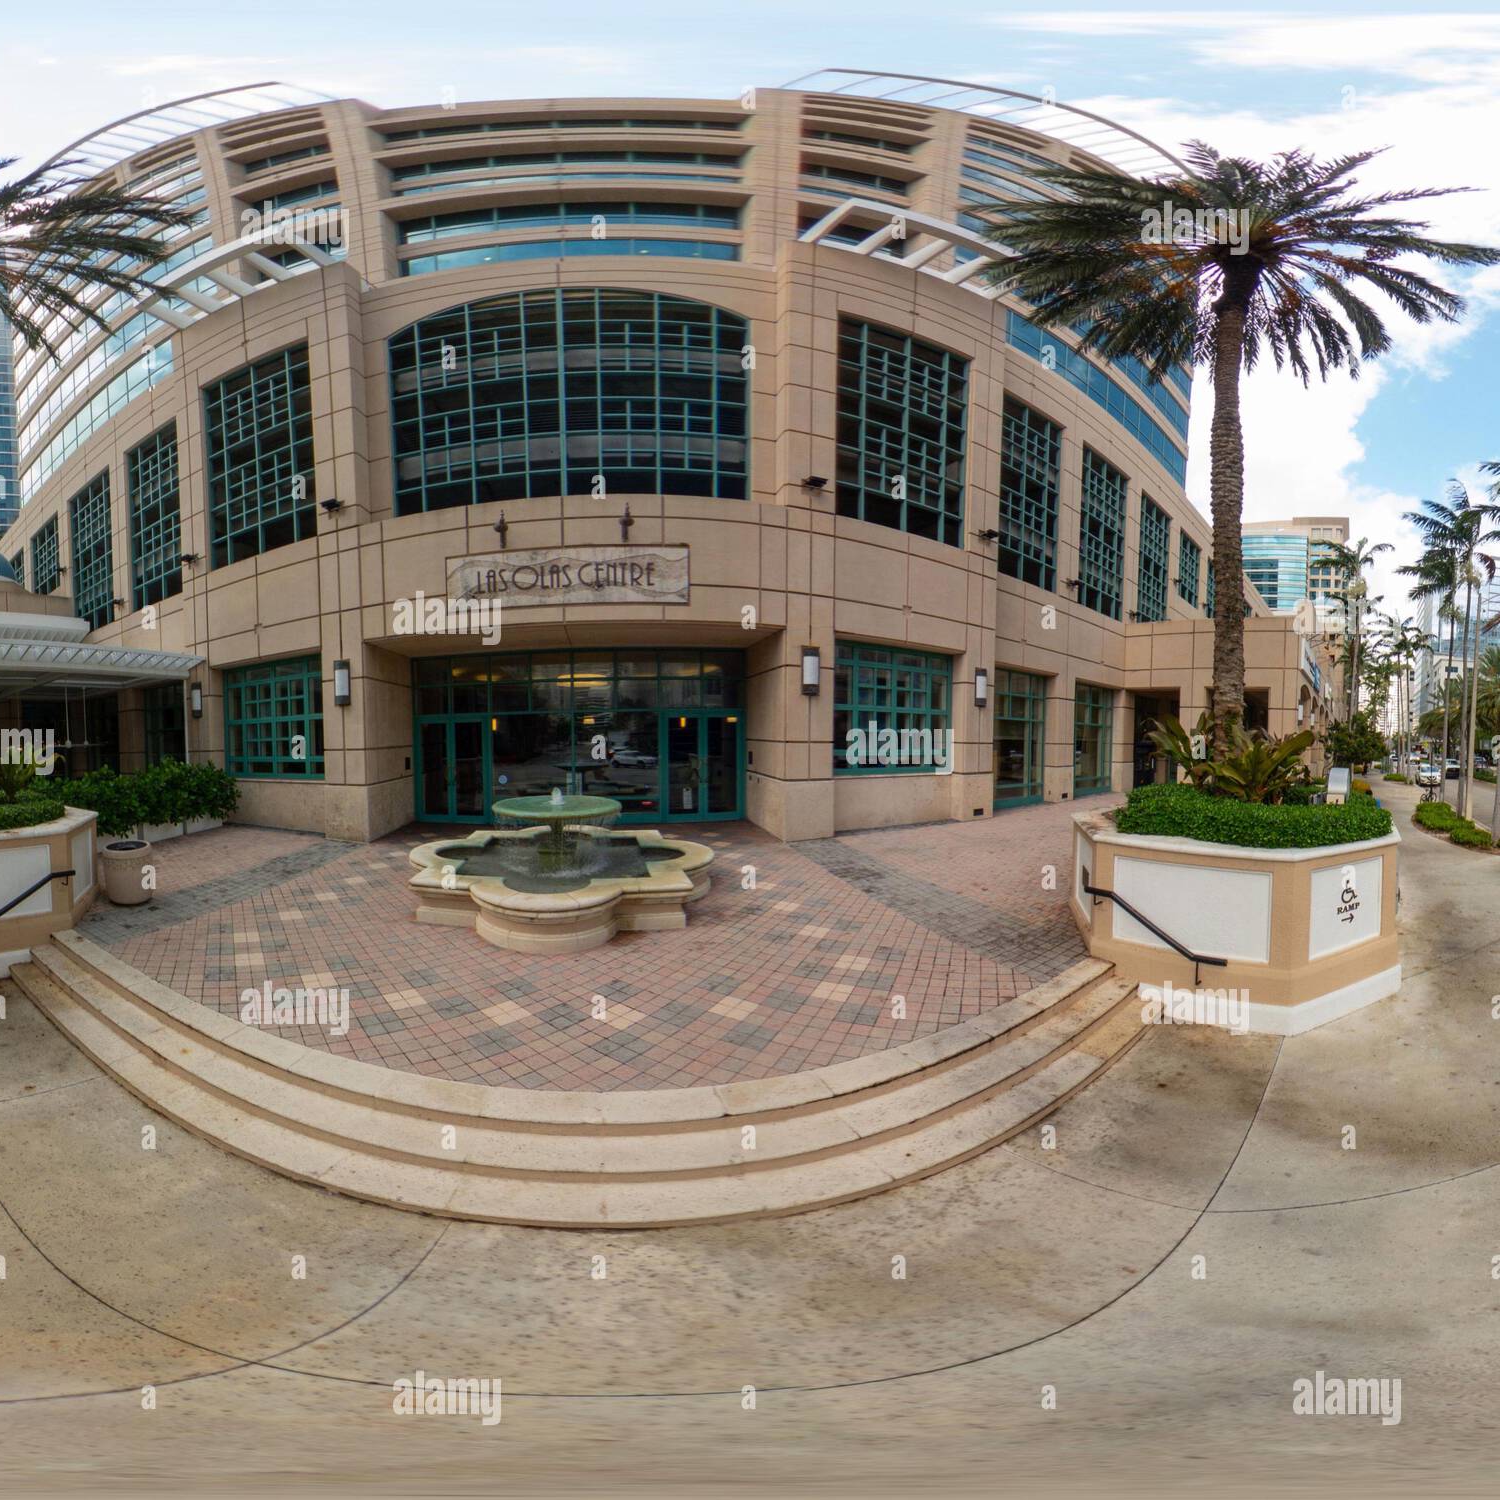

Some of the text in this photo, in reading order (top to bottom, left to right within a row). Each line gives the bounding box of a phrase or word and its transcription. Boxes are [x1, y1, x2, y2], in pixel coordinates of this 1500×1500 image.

[476, 561, 655, 595] LAS OLAS CENTRE
[1336, 902, 1360, 915] RAMP
